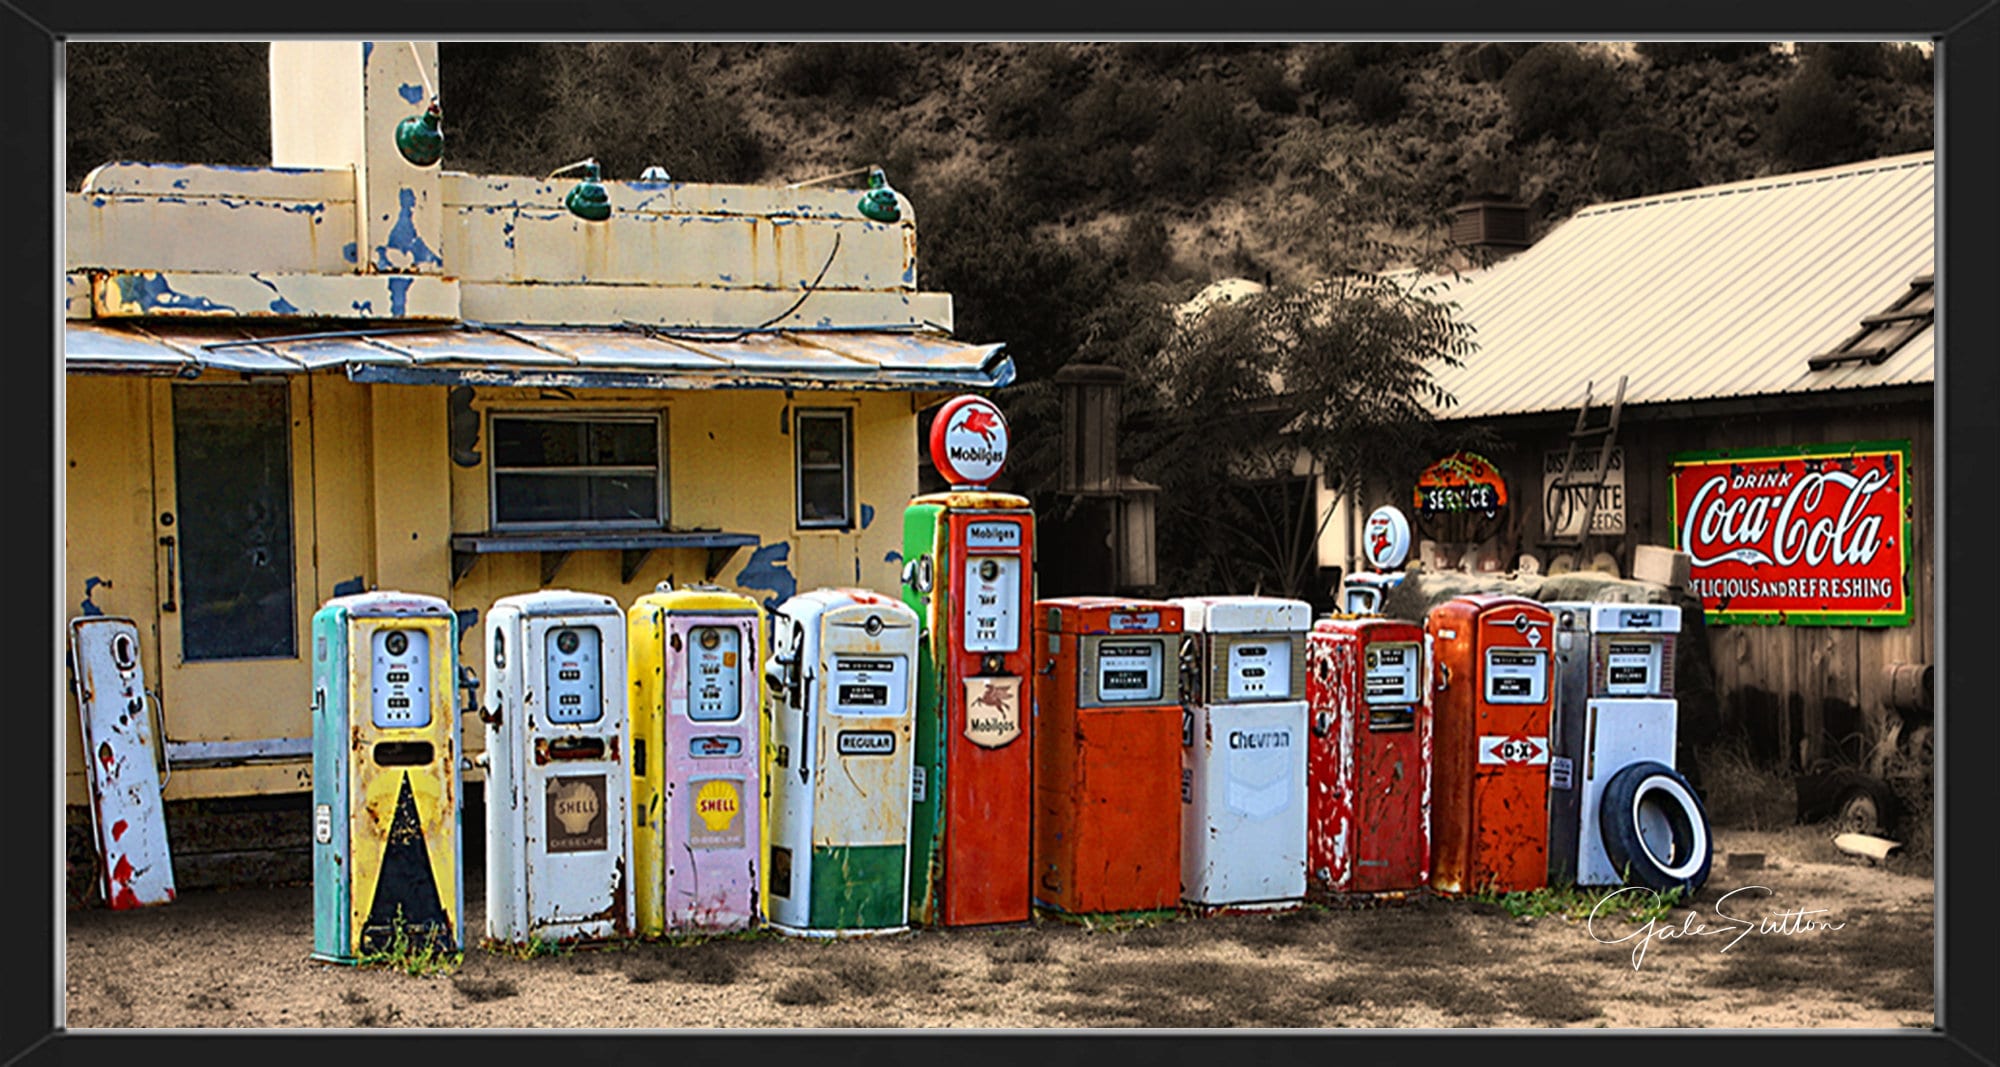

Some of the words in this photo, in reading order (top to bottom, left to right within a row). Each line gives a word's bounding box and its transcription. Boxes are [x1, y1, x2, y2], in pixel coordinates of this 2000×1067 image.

[951, 447, 1003, 467] Mobilgas
[1732, 472, 1793, 489] DRINK
[1682, 468, 1893, 567] Coca-Cola
[971, 527, 1015, 542] Mobilgas
[1788, 577, 1893, 598] REFRESHING
[971, 718, 1015, 736] Mobilgas
[843, 737, 890, 749] REGULAR
[1229, 730, 1290, 750] Chevron
[558, 801, 594, 815] SHELL
[700, 799, 735, 813] SHELL
